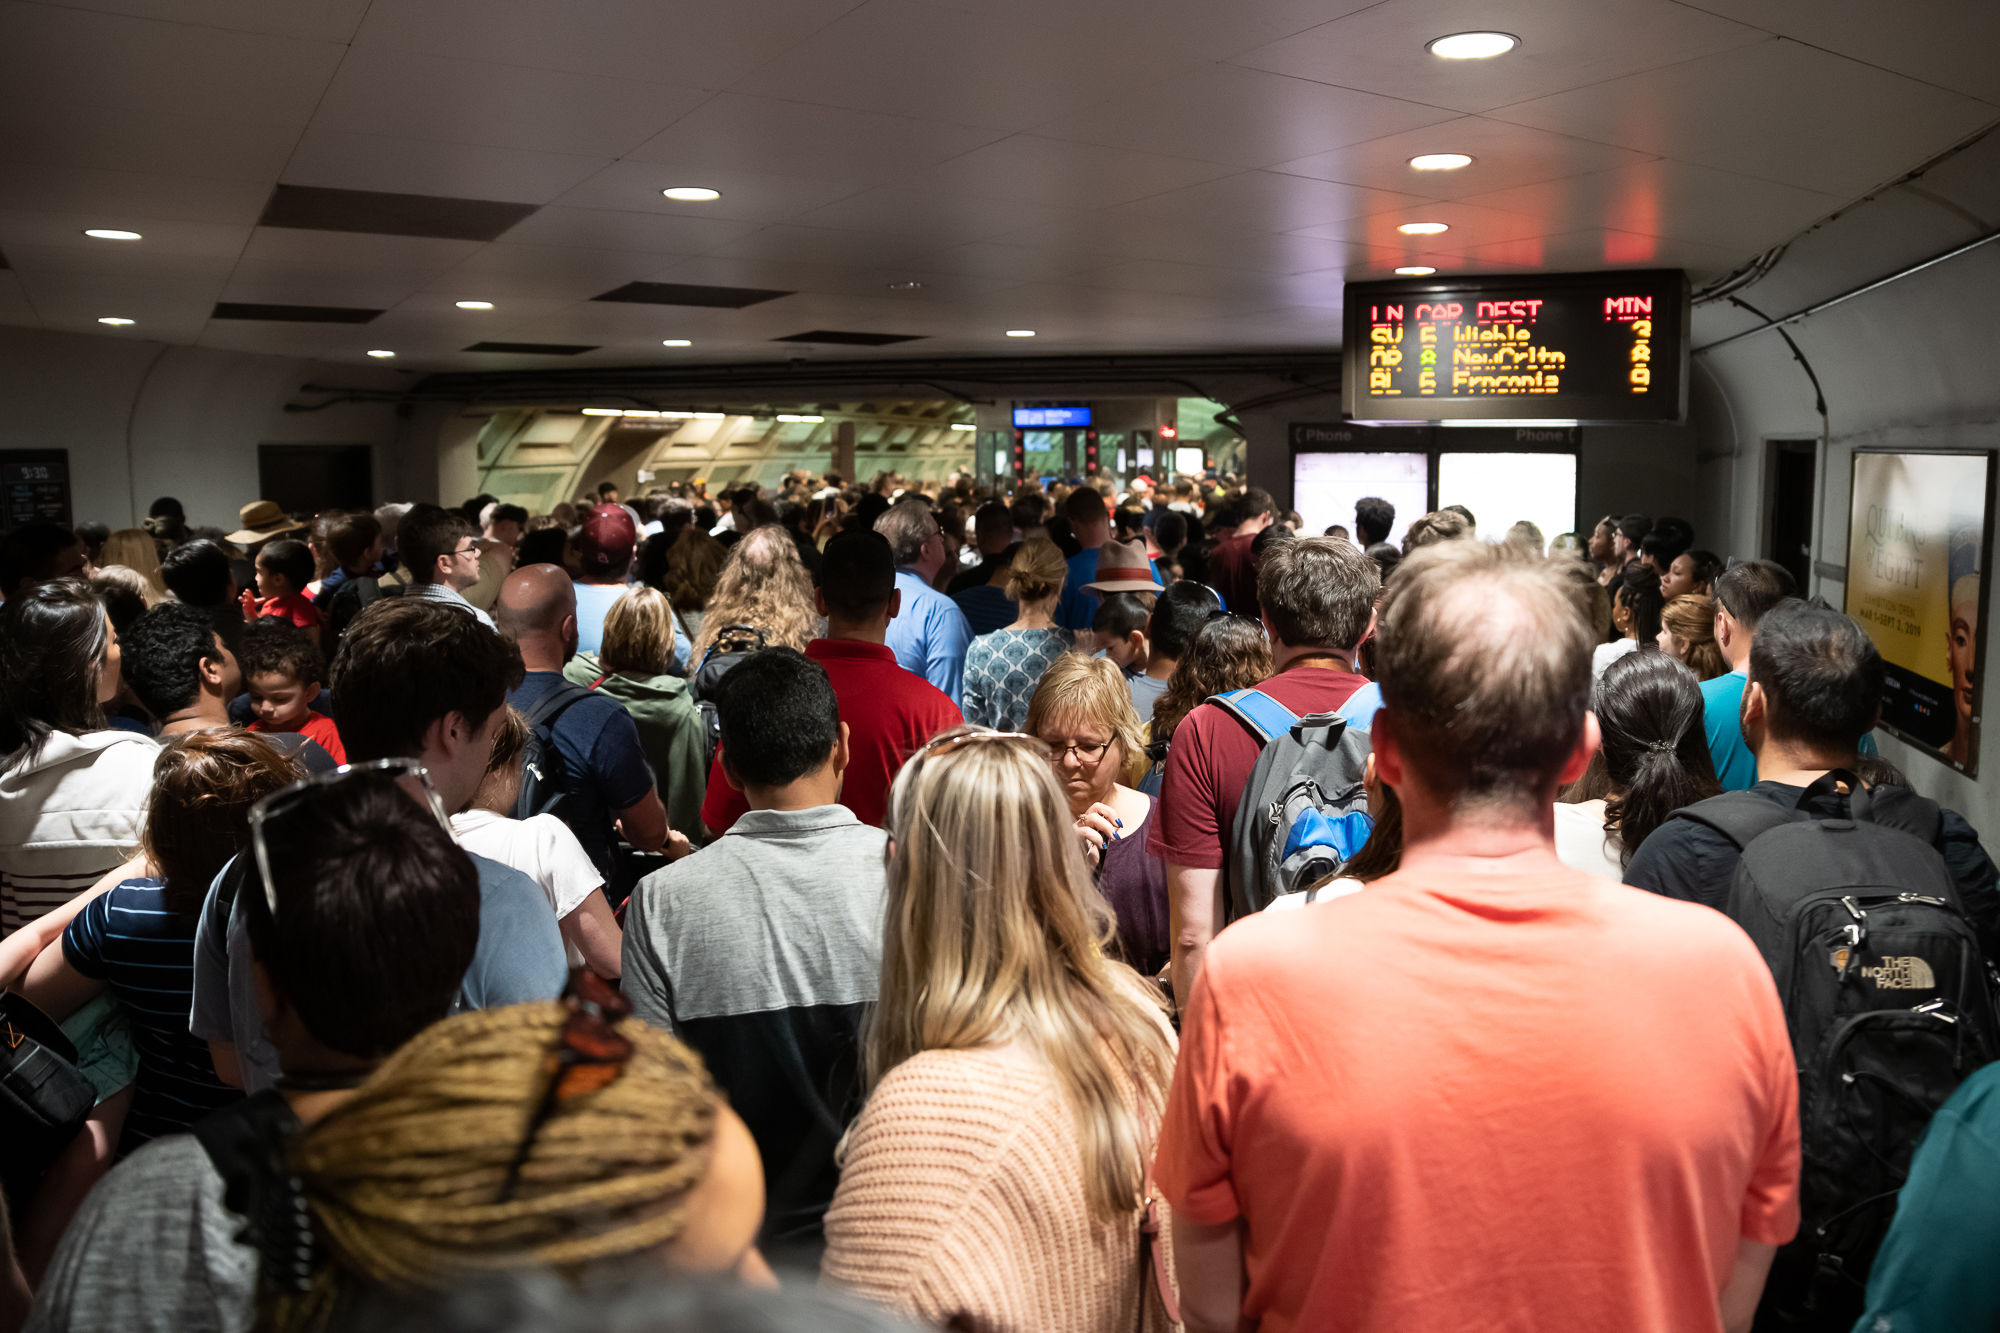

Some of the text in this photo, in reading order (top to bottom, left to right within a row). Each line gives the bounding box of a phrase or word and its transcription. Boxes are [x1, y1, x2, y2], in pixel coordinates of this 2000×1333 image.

[1604, 295, 1652, 321] MIN
[1305, 428, 1352, 442] Phone
[1515, 428, 1564, 441] Phone
[1880, 955, 1911, 967] THE
[1861, 966, 1911, 979] NORTH
[1875, 977, 1911, 989] FACE
